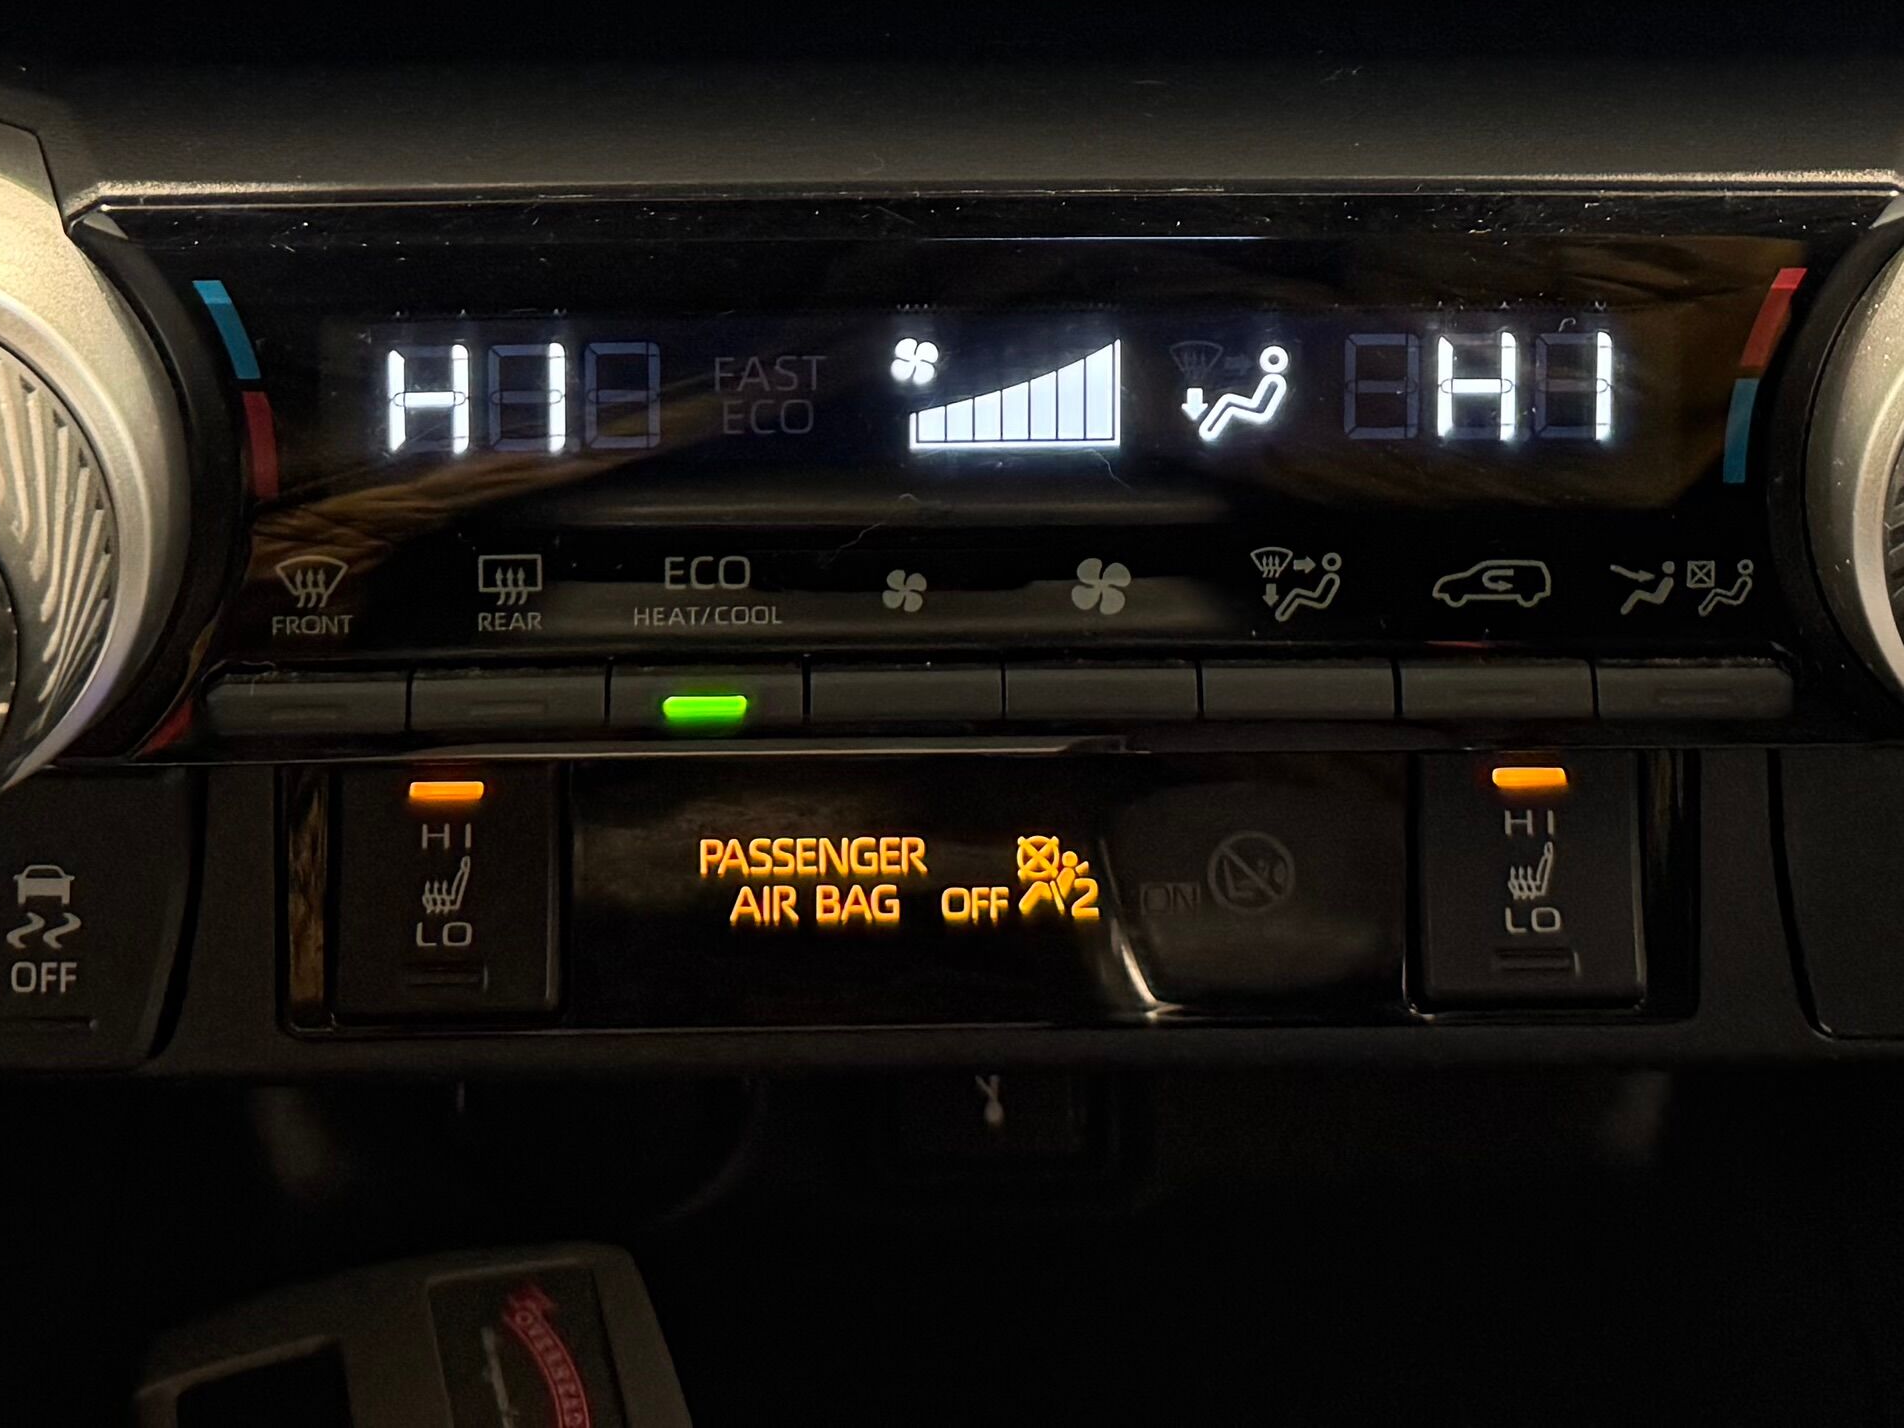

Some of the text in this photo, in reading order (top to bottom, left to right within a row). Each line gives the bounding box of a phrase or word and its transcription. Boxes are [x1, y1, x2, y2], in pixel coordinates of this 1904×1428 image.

[713, 355, 826, 393] FAST
[1437, 330, 1613, 444] HI
[388, 342, 566, 456] HI
[722, 399, 815, 436] ECO
[664, 555, 752, 591] ECO
[271, 615, 354, 638] FRONT
[477, 611, 543, 633] REAR
[633, 604, 783, 628] HEAT/COOL
[421, 823, 473, 851] HI
[1504, 809, 1555, 836] HI
[699, 836, 928, 877] PASSENGER
[729, 884, 900, 925] AIR BAG
[941, 886, 1010, 922] OFF
[1504, 907, 1562, 934] LO
[416, 921, 473, 947] LO
[10, 961, 78, 994] OFF
